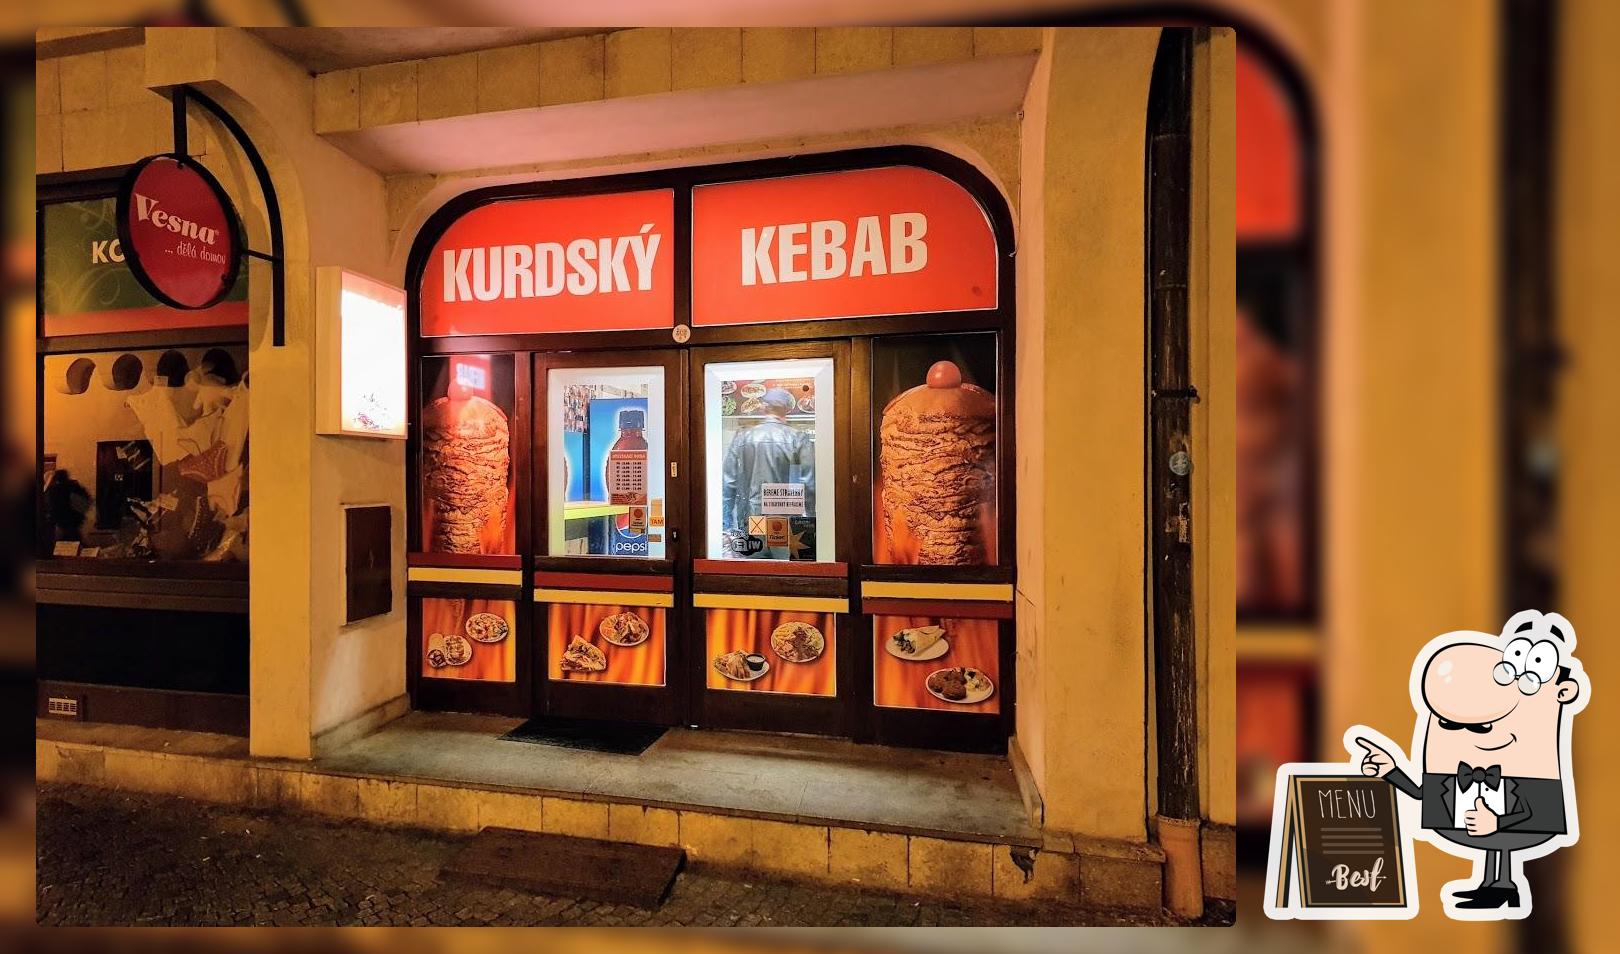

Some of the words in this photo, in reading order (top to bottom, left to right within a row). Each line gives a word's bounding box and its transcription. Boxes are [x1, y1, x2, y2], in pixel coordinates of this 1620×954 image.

[134, 193, 216, 245] Vesna
[443, 223, 662, 302] KURDSKÝ
[741, 212, 928, 286] KEBAB
[616, 542, 647, 553] pepsi
